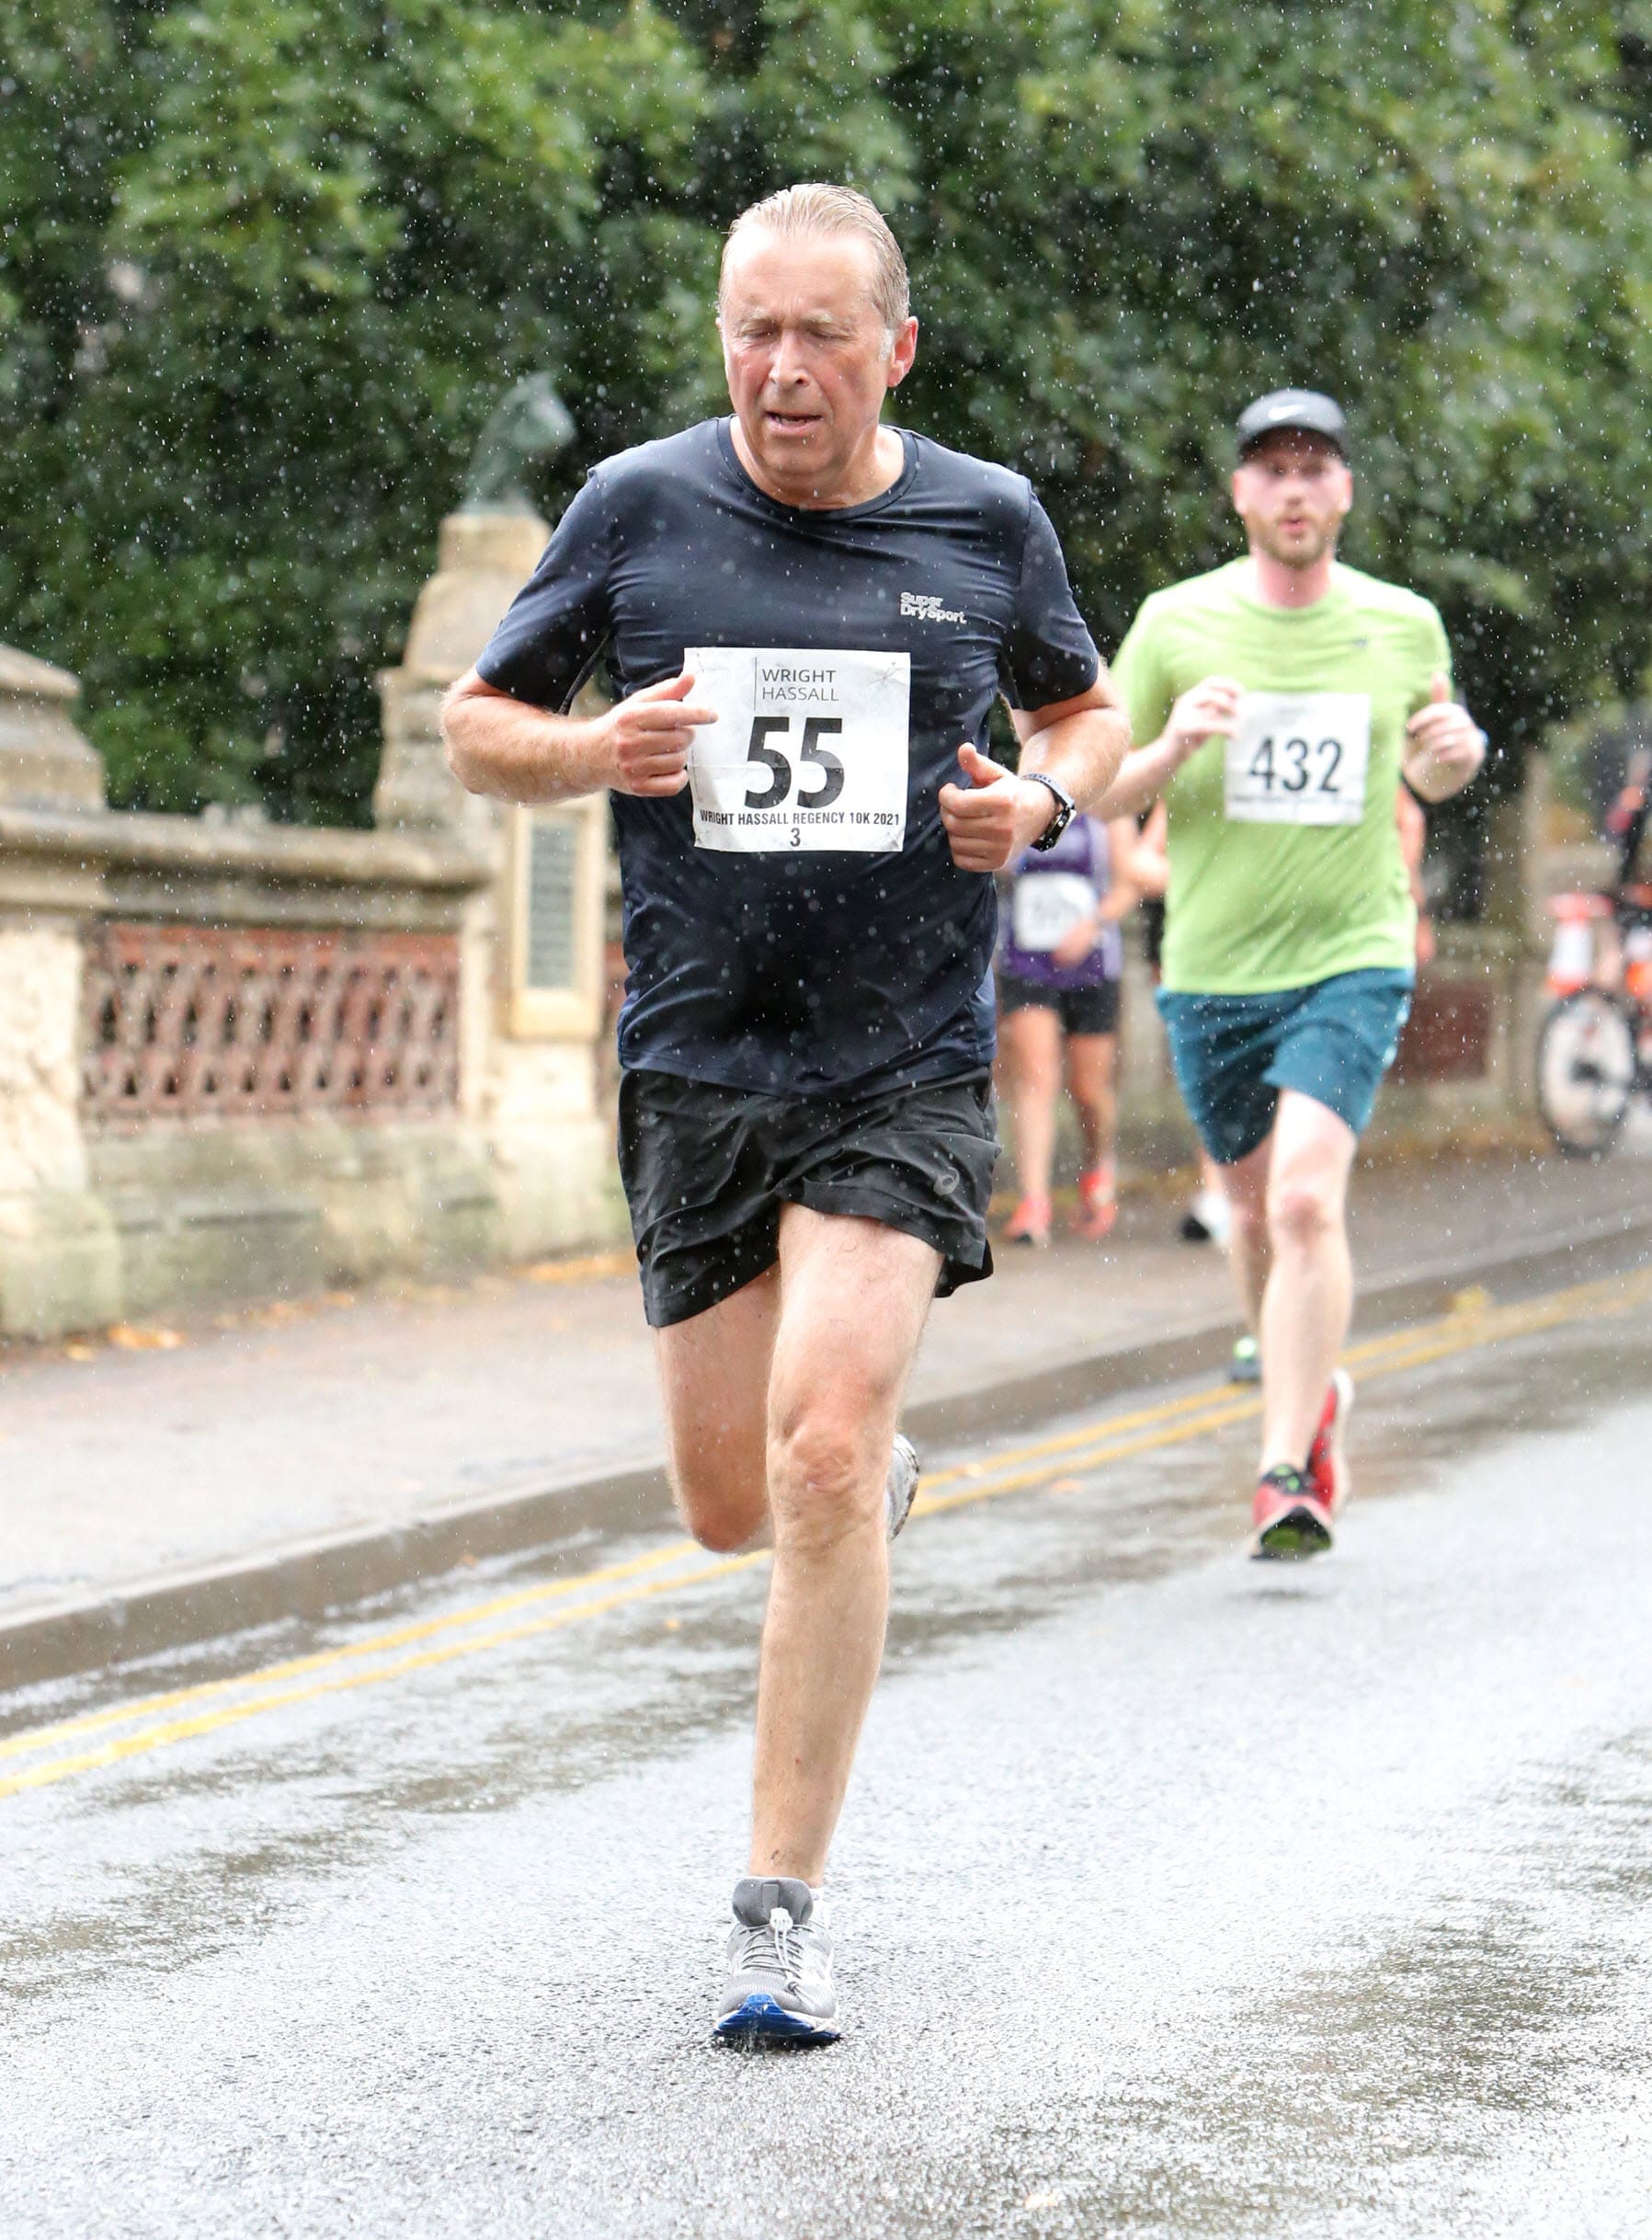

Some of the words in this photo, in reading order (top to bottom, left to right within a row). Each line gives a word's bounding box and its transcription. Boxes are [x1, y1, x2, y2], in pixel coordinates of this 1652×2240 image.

[900, 592, 943, 607] Super
[761, 669, 837, 683] WRIGHT
[761, 687, 839, 702] HASSALL
[744, 716, 845, 809] 55
[1249, 737, 1342, 793] 432
[700, 809, 735, 826] WRIGHT
[738, 813, 789, 826] HASSALL
[792, 812, 844, 825] REGENCY
[849, 812, 871, 825] 10K
[873, 813, 900, 826] 2021
[789, 828, 802, 847] 3
